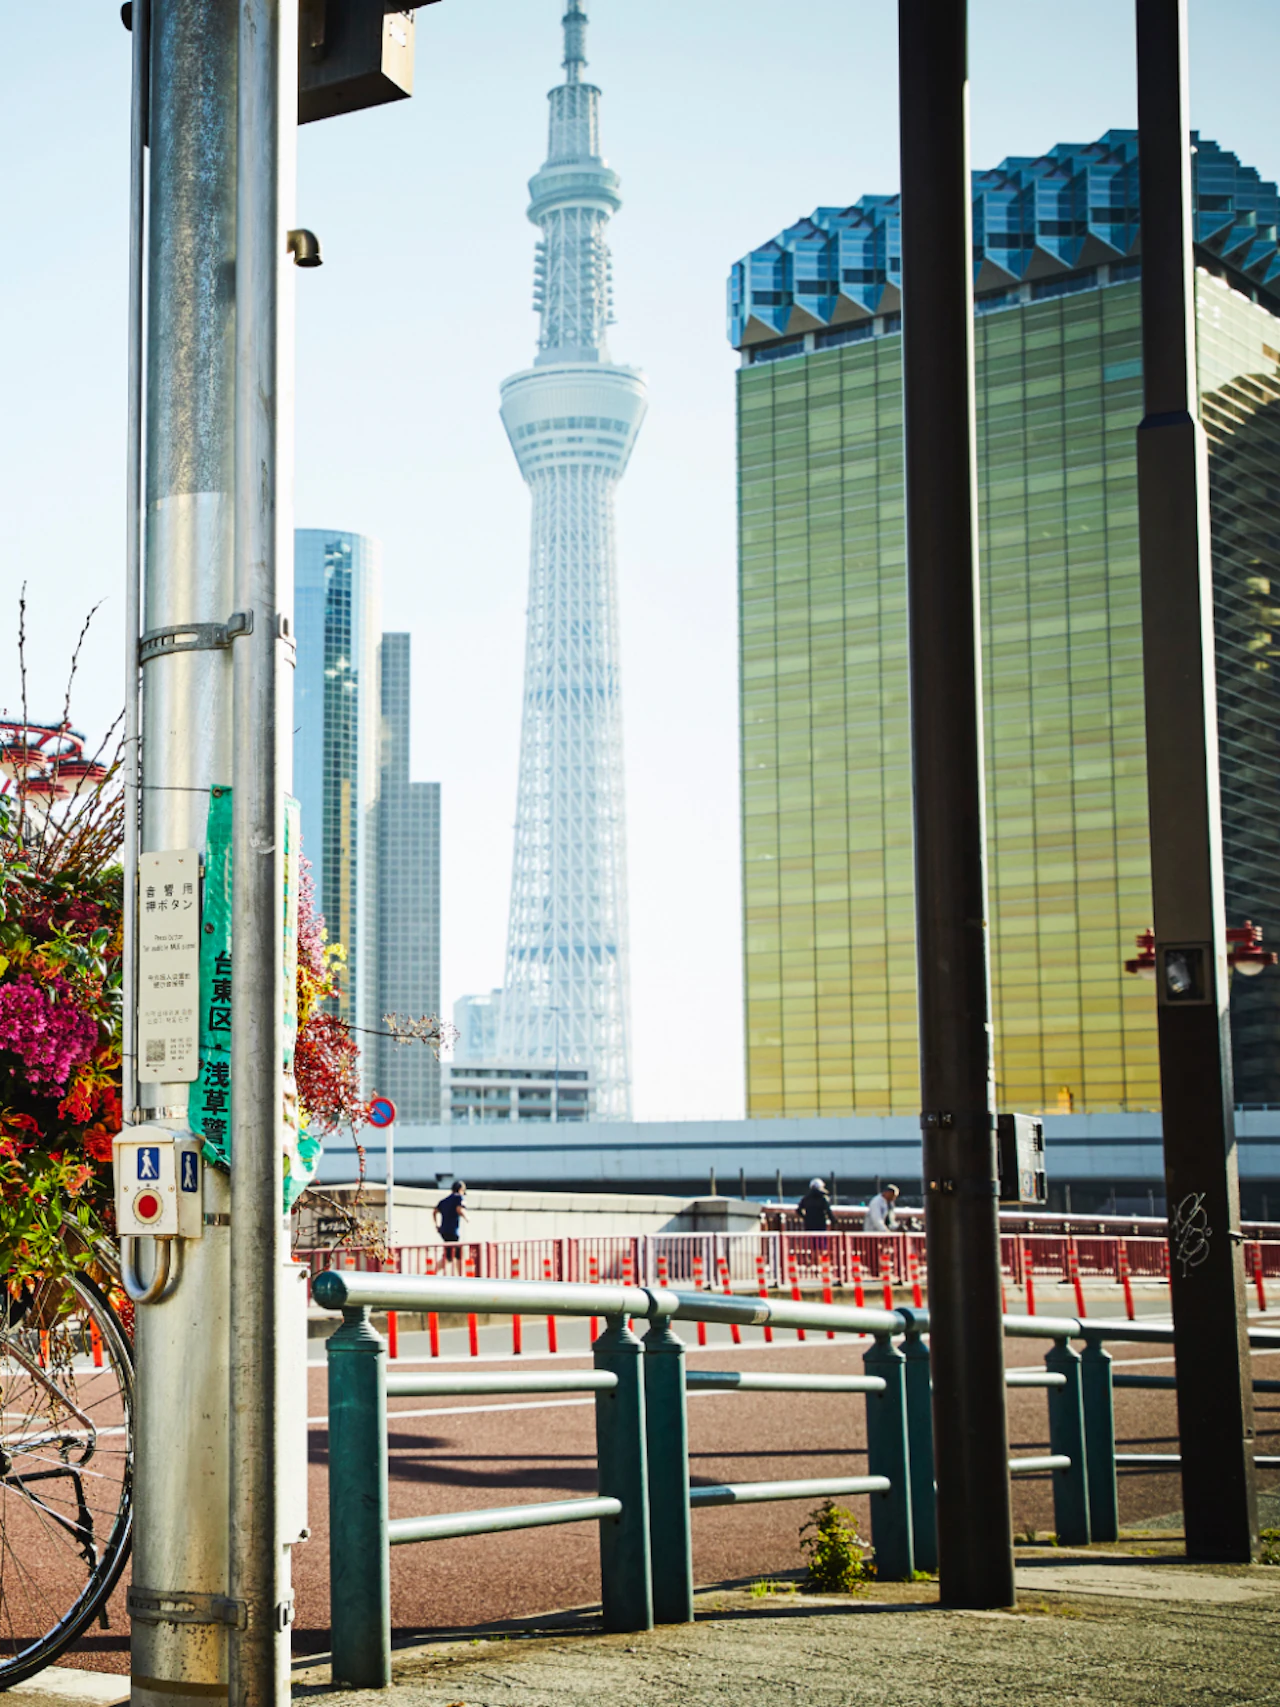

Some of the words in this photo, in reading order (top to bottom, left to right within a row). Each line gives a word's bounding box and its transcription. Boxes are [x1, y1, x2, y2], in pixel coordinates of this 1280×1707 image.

[145, 882, 194, 898] 音響用
[145, 899, 193, 913] 押ボタン
